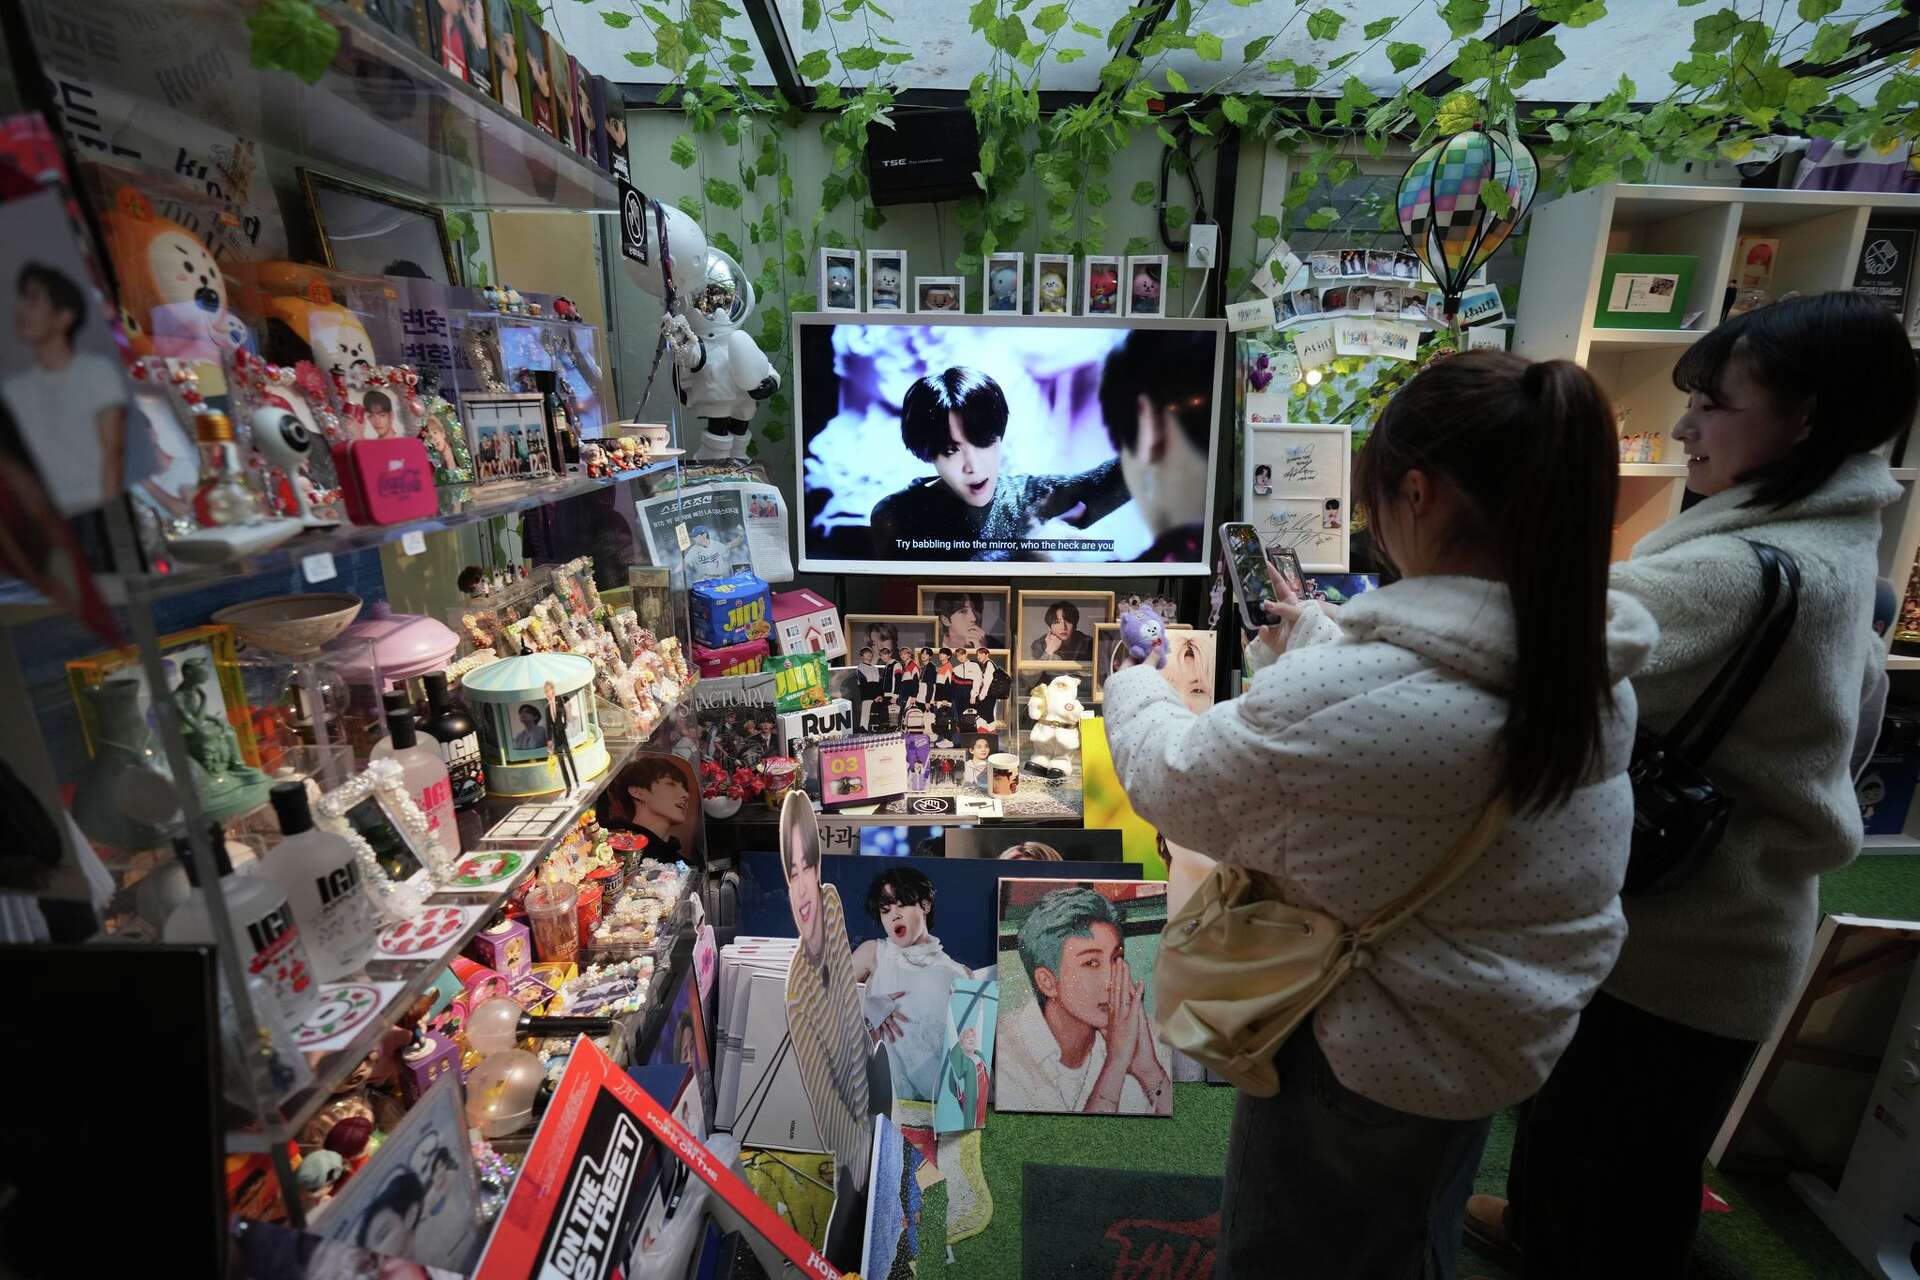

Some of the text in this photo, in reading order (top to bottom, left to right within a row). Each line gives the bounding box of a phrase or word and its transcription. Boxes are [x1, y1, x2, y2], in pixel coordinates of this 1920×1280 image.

[896, 540, 910, 550] Try
[912, 540, 951, 550] babbling
[953, 540, 971, 549] into
[972, 540, 987, 549] the
[989, 540, 1018, 551] mirror,
[1021, 540, 1040, 550] who
[1042, 541, 1056, 550] the
[1058, 541, 1079, 550] heck
[1098, 543, 1114, 552] you
[679, 687, 766, 717] SANCTUARY
[801, 711, 851, 737] RUN
[831, 757, 859, 774] 03
[574, 1124, 635, 1280] STREET
[555, 1227, 583, 1277] ON
[570, 1173, 602, 1229] THE
[806, 1251, 842, 1280] HOP
